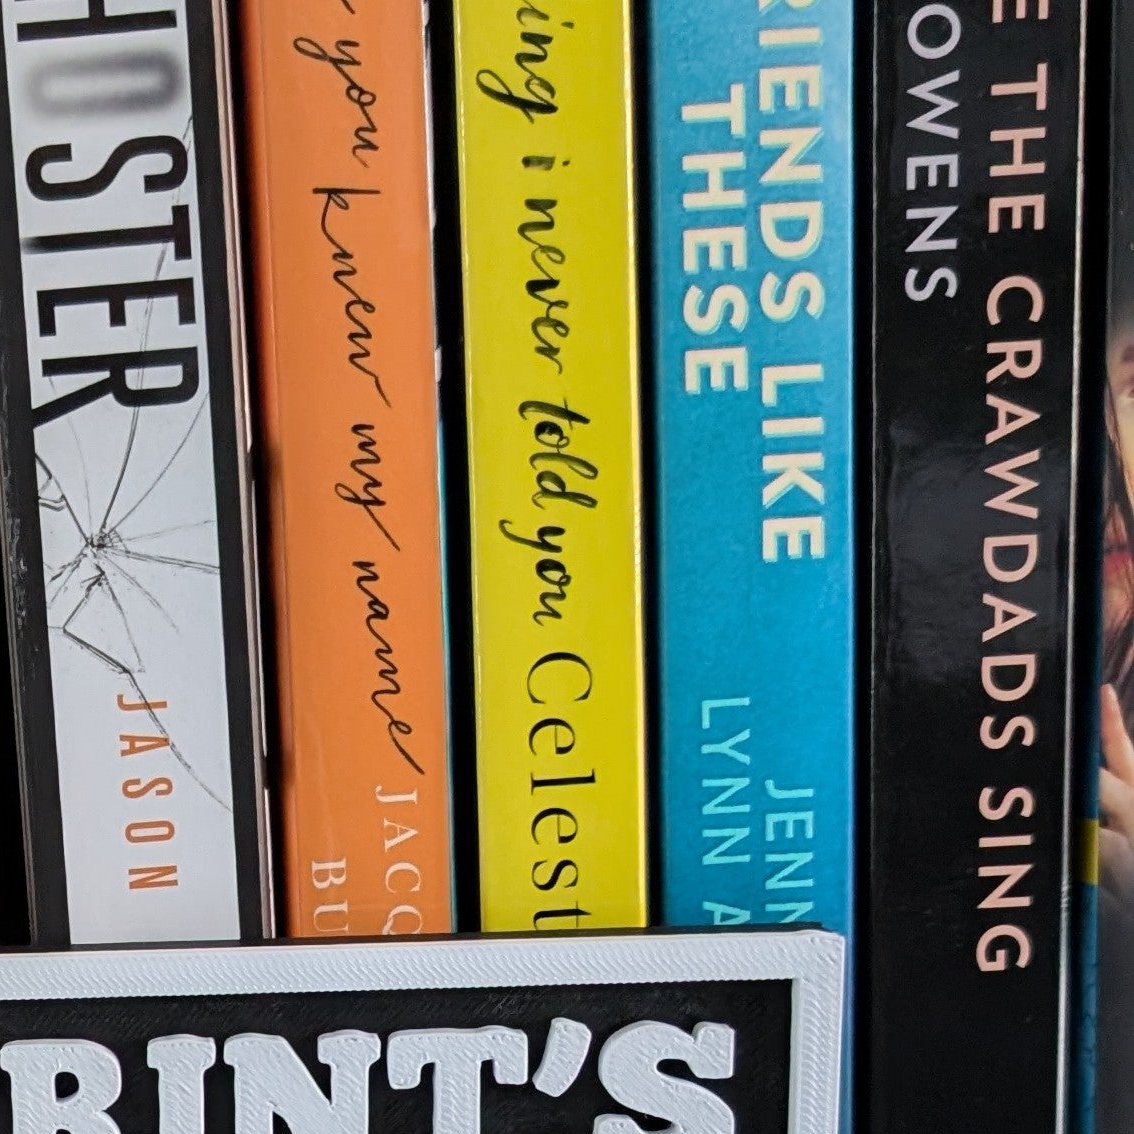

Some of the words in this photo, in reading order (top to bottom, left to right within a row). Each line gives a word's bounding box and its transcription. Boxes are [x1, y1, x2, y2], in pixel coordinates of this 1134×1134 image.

[294, 37, 379, 168] you
[758, 0, 824, 322] IENDS
[904, 4, 962, 302] OWENS
[988, 63, 1048, 233] THE
[313, 187, 391, 408] knew
[517, 198, 570, 374] never
[680, 84, 749, 395] THESE
[335, 424, 400, 552] my
[518, 397, 598, 510] told
[761, 362, 826, 563] LIKE
[979, 275, 1044, 750] CRAWDADS
[353, 560, 425, 775] name
[498, 518, 571, 626] you
[116, 694, 178, 890] JASON
[526, 651, 596, 931] Celest
[701, 697, 750, 865] LYNN
[976, 787, 1034, 972] SING
